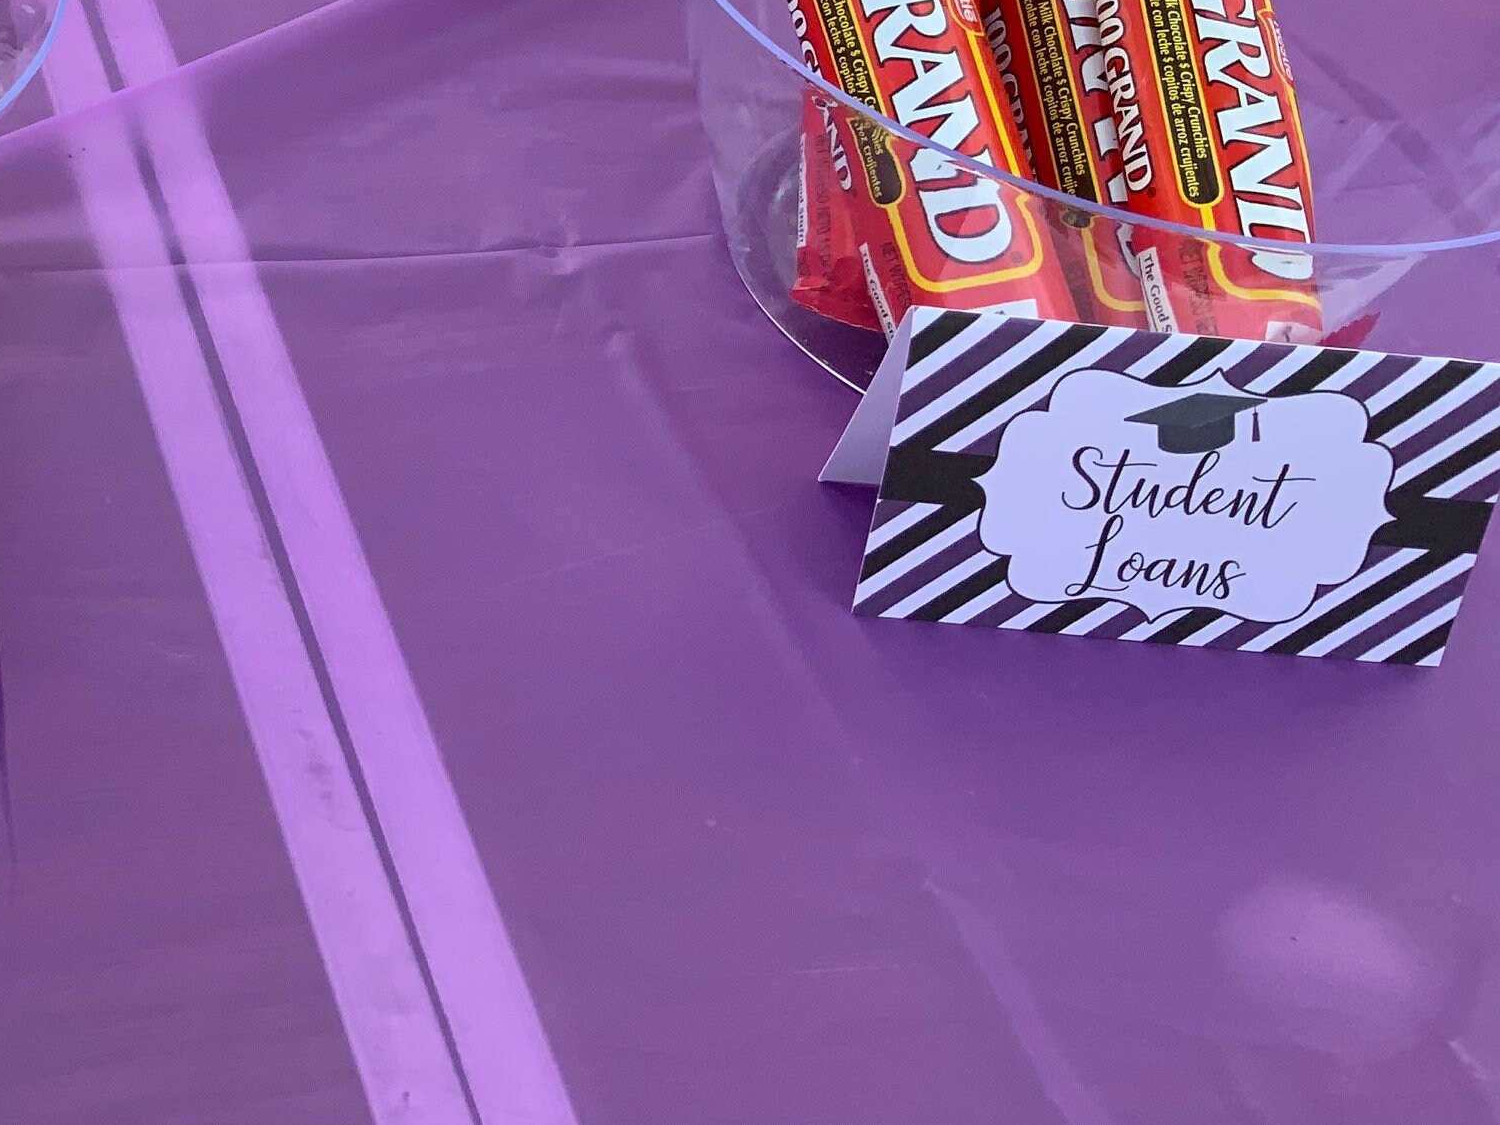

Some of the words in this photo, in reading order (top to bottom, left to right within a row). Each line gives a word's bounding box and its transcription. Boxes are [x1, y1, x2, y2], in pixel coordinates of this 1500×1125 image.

[1037, 0, 1054, 26] Milk
[1152, 8, 1164, 27] con
[1031, 28, 1043, 48] con
[1043, 26, 1063, 79] Chocolate
[1156, 28, 1172, 55] leche
[1167, 10, 1188, 61] Chocolate
[852, 57, 871, 98] Crispy
[1035, 46, 1051, 76] leche
[1161, 63, 1182, 102] copitos
[1179, 70, 1196, 104] Crispy
[826, 13, 841, 47] leche
[838, 55, 857, 96] copitos
[862, 144, 883, 200] crujientes
[1043, 84, 1060, 122] copitos
[1056, 86, 1074, 121] Crispy
[1103, 45, 1153, 193] GRAND
[1171, 101, 1186, 117] de
[1052, 119, 1063, 135] de
[1173, 117, 1189, 146] arroz
[1187, 104, 1208, 160] Crunchies
[1054, 135, 1069, 165] arroz
[1065, 121, 1086, 177] Crunchies
[1179, 146, 1201, 199] crujientes
[1143, 253, 1154, 279] The
[1148, 277, 1168, 316] Good
[1062, 444, 1318, 530] Student
[1064, 513, 1248, 601] Loans
